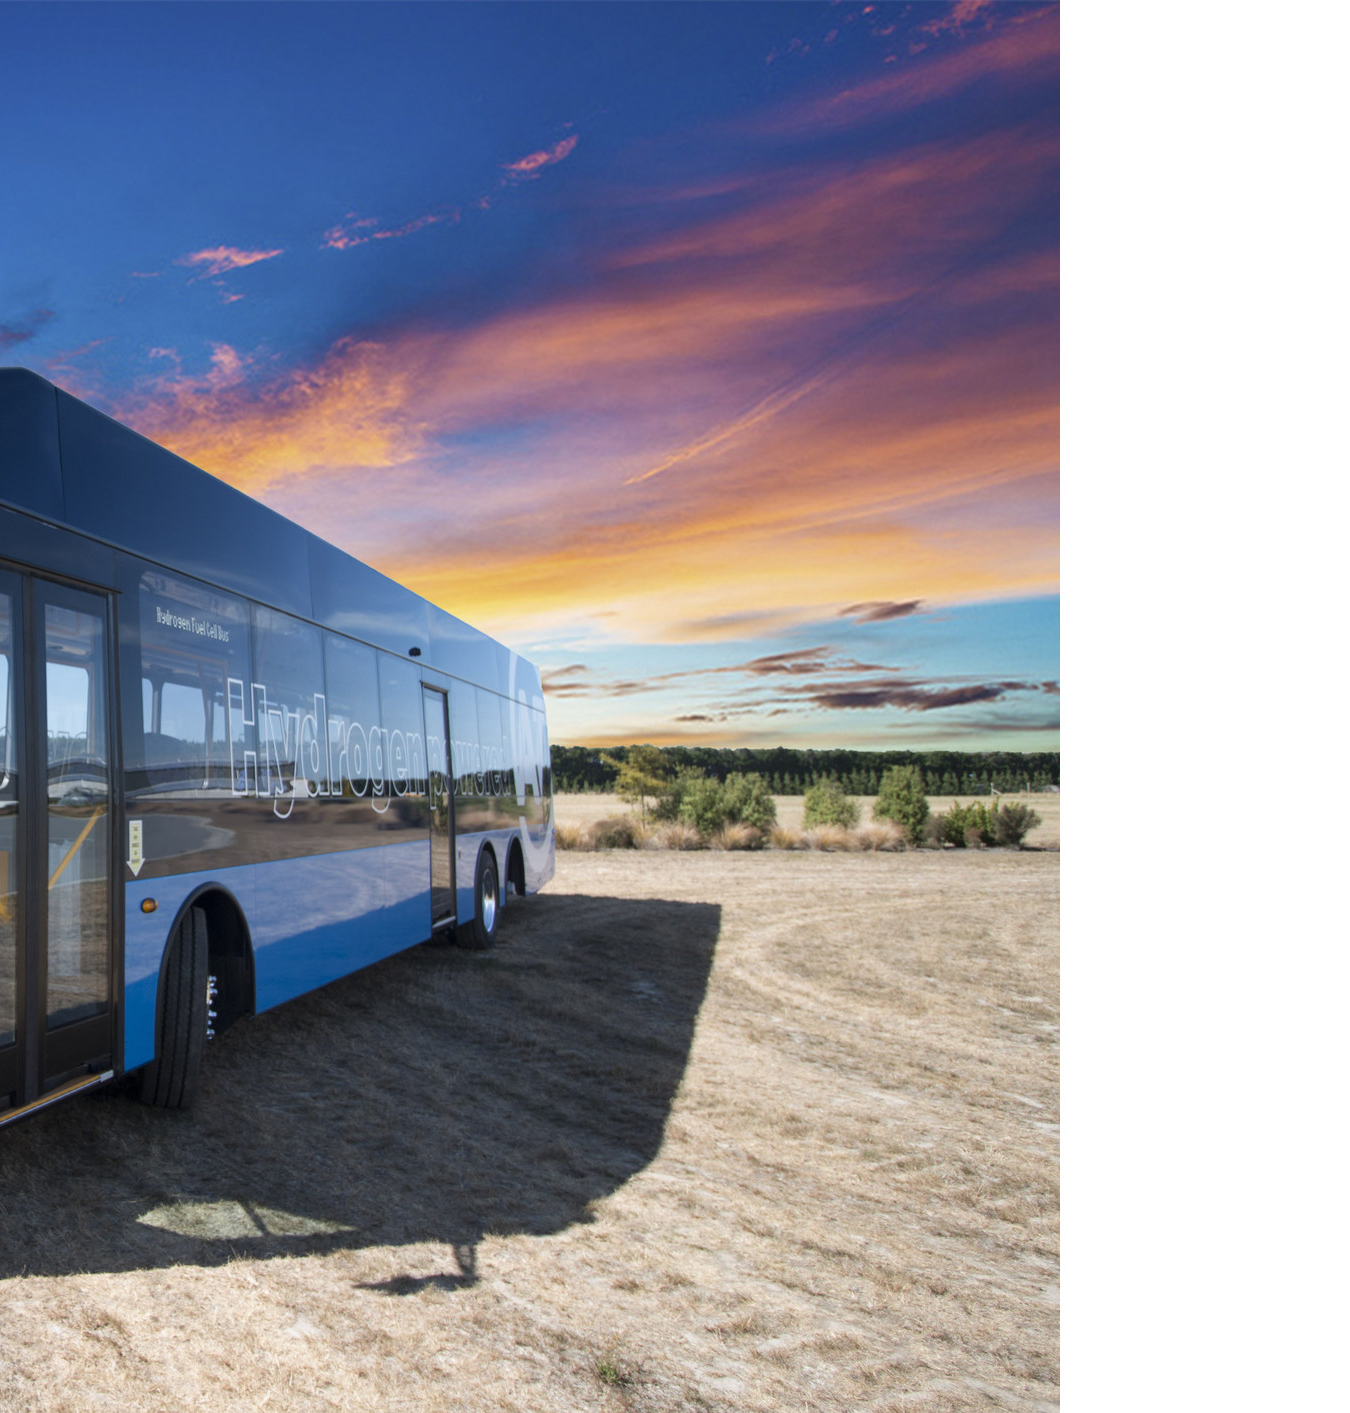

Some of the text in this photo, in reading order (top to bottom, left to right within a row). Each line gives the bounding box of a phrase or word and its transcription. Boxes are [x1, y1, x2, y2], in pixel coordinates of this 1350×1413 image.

[156, 606, 191, 631] Hydrogen
[191, 617, 206, 636] Fuel
[206, 621, 217, 639] Cell
[227, 678, 426, 818] Hydrogen
